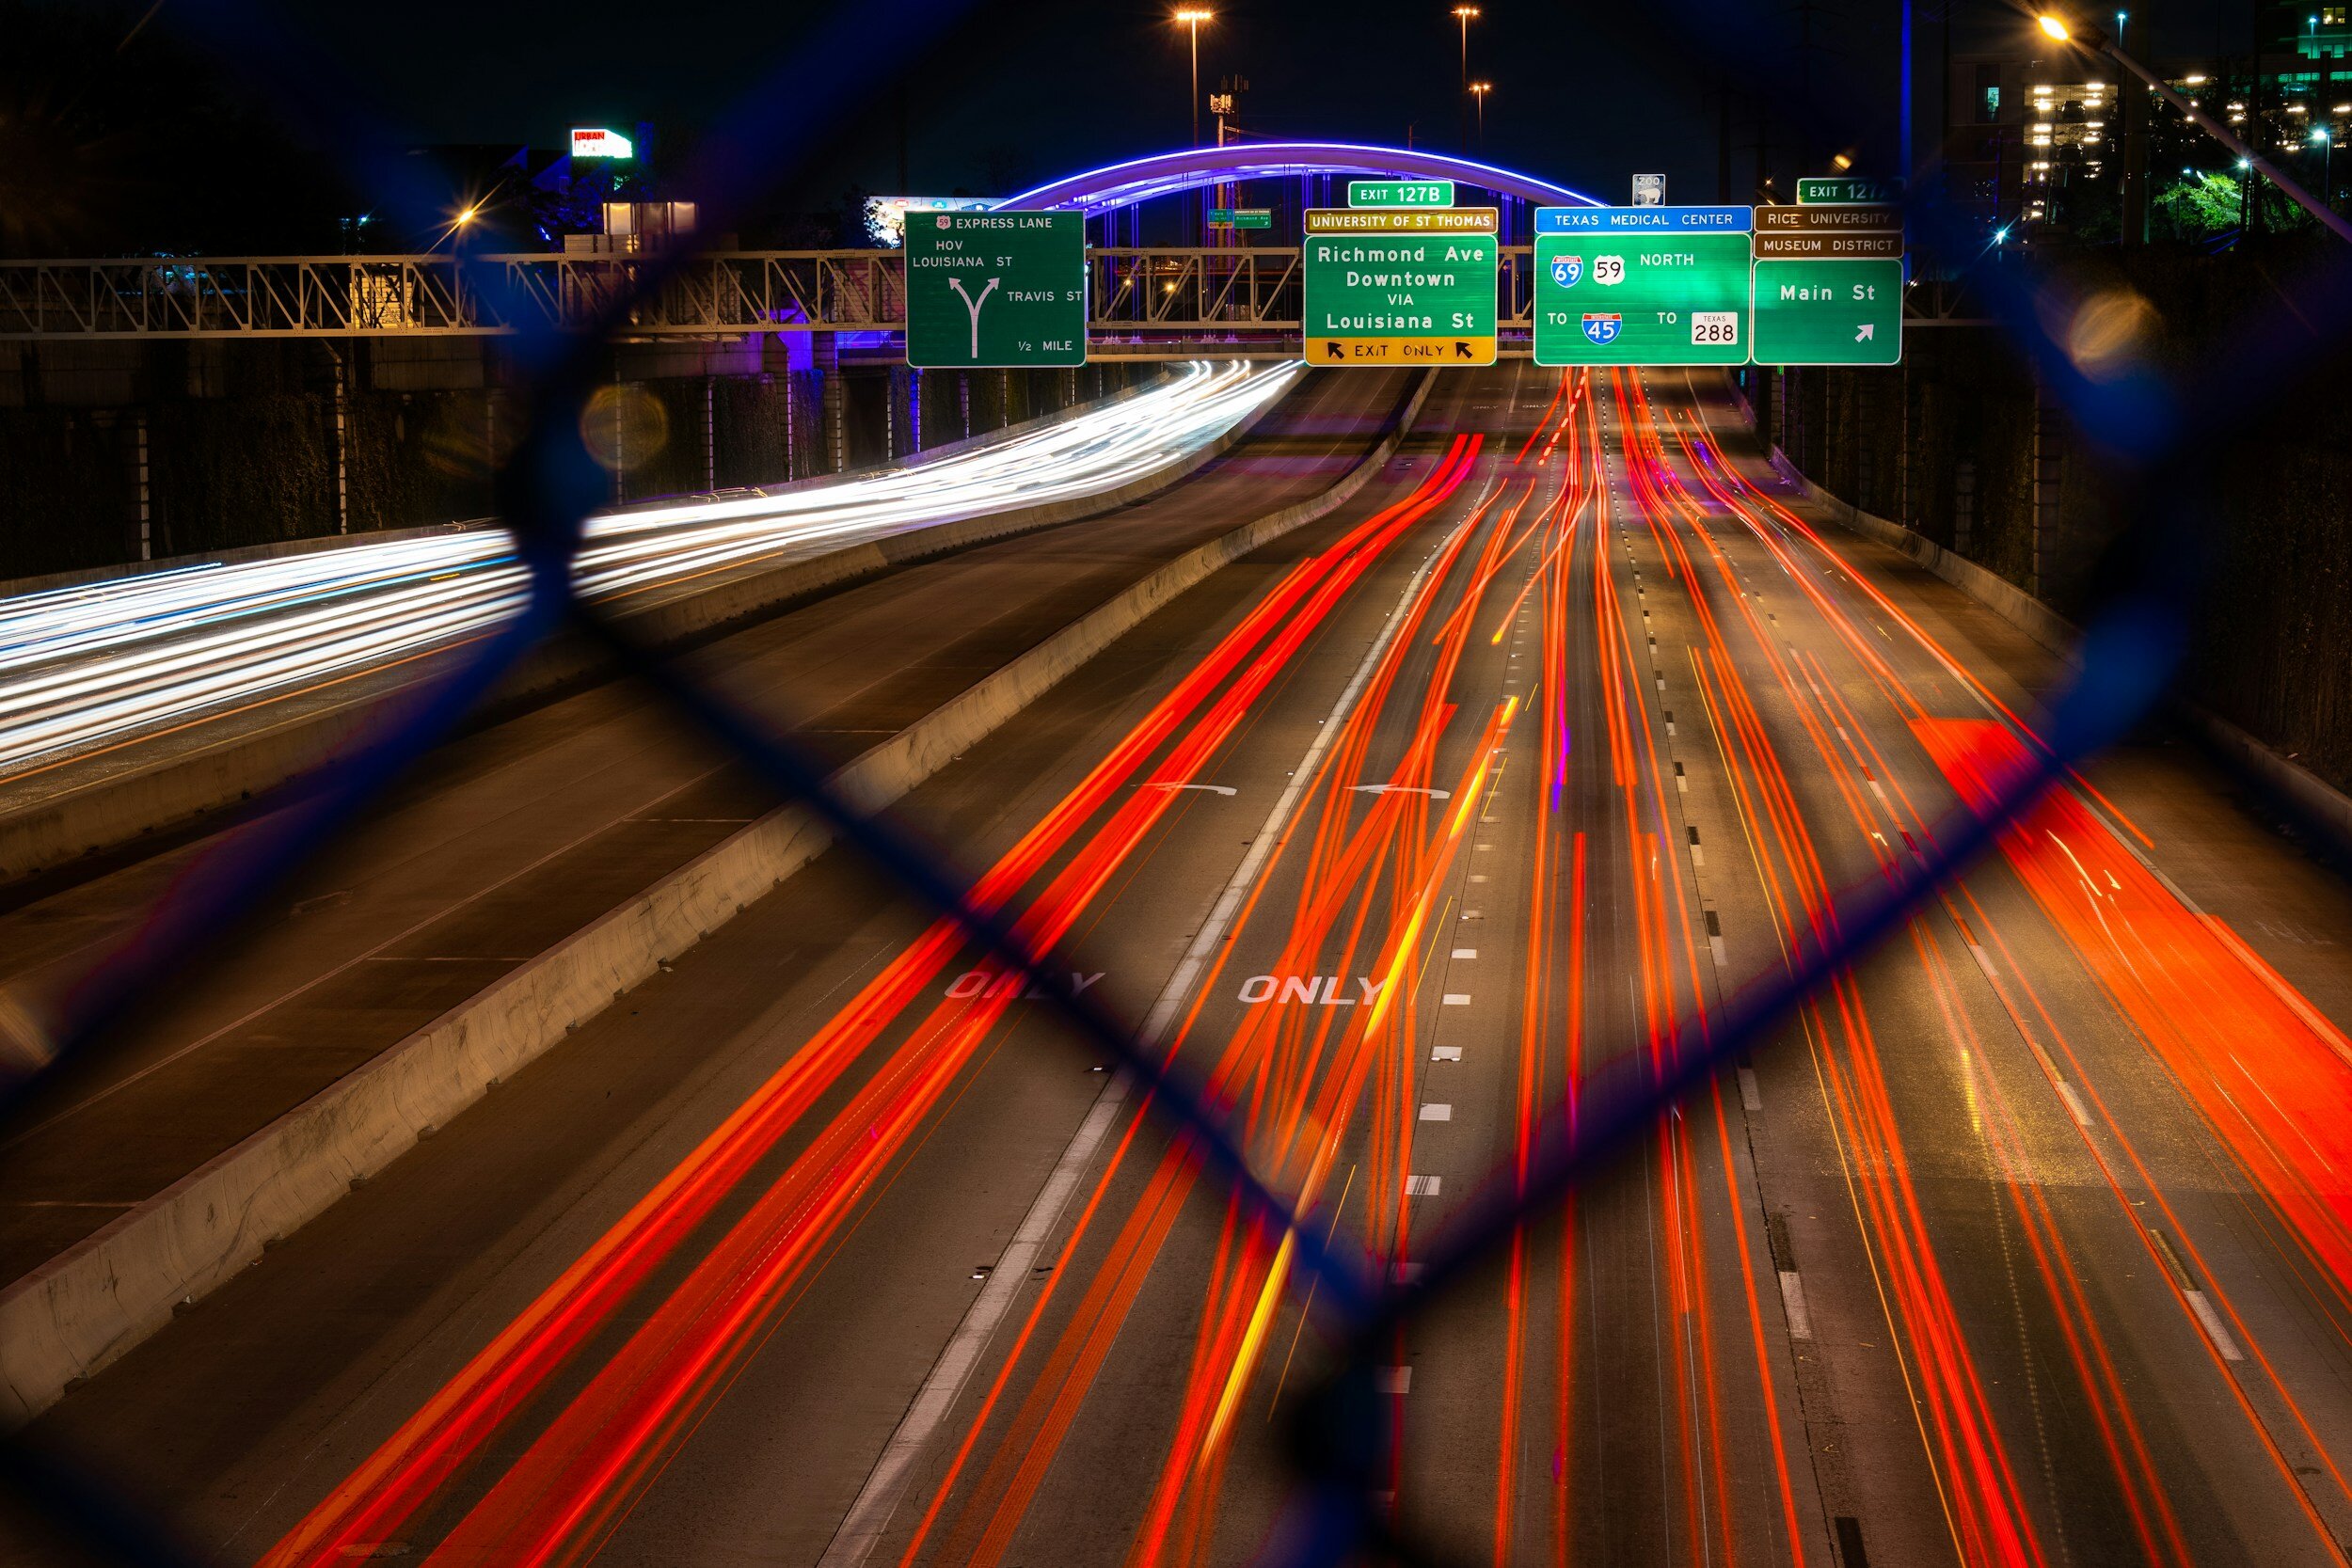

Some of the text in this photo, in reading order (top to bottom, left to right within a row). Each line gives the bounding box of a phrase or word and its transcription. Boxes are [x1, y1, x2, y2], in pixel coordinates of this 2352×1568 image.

[575, 132, 605, 140] URBAN
[1639, 177, 1661, 185] ZOO
[1360, 187, 1440, 202] EXIT 127B
[1810, 183, 1889, 199] EXIT 127
[956, 218, 1014, 229] EXPRESS
[1019, 217, 1053, 228] LANE
[1312, 215, 1490, 228] UNIVERSITY OF ST THOMAS
[1555, 214, 1733, 226] TEXAS MEDICAL CENTER
[1768, 214, 1890, 224] RICE UNIVERSITY
[936, 240, 963, 250] HOV
[1764, 240, 1894, 251] MUSEUM DISTRICT
[1318, 245, 1484, 262] Richmond Ave
[913, 256, 1012, 267] LOUISIANA ST
[1555, 254, 1693, 281] 69 59 NORTH
[1346, 271, 1454, 287] Downtown
[1007, 291, 1082, 302] TRAVIS ST
[1780, 284, 1875, 301] Main St
[1388, 293, 1414, 306] VIA
[1327, 313, 1474, 329] Louisiana St
[1548, 312, 1567, 325] TO
[1657, 312, 1677, 324] TO
[1588, 322, 1614, 339] 45
[1695, 325, 1734, 341] 288
[1042, 341, 1073, 351] MILE
[1355, 344, 1445, 356] EXIT ONLY
[1237, 974, 1389, 1006] ONLY
